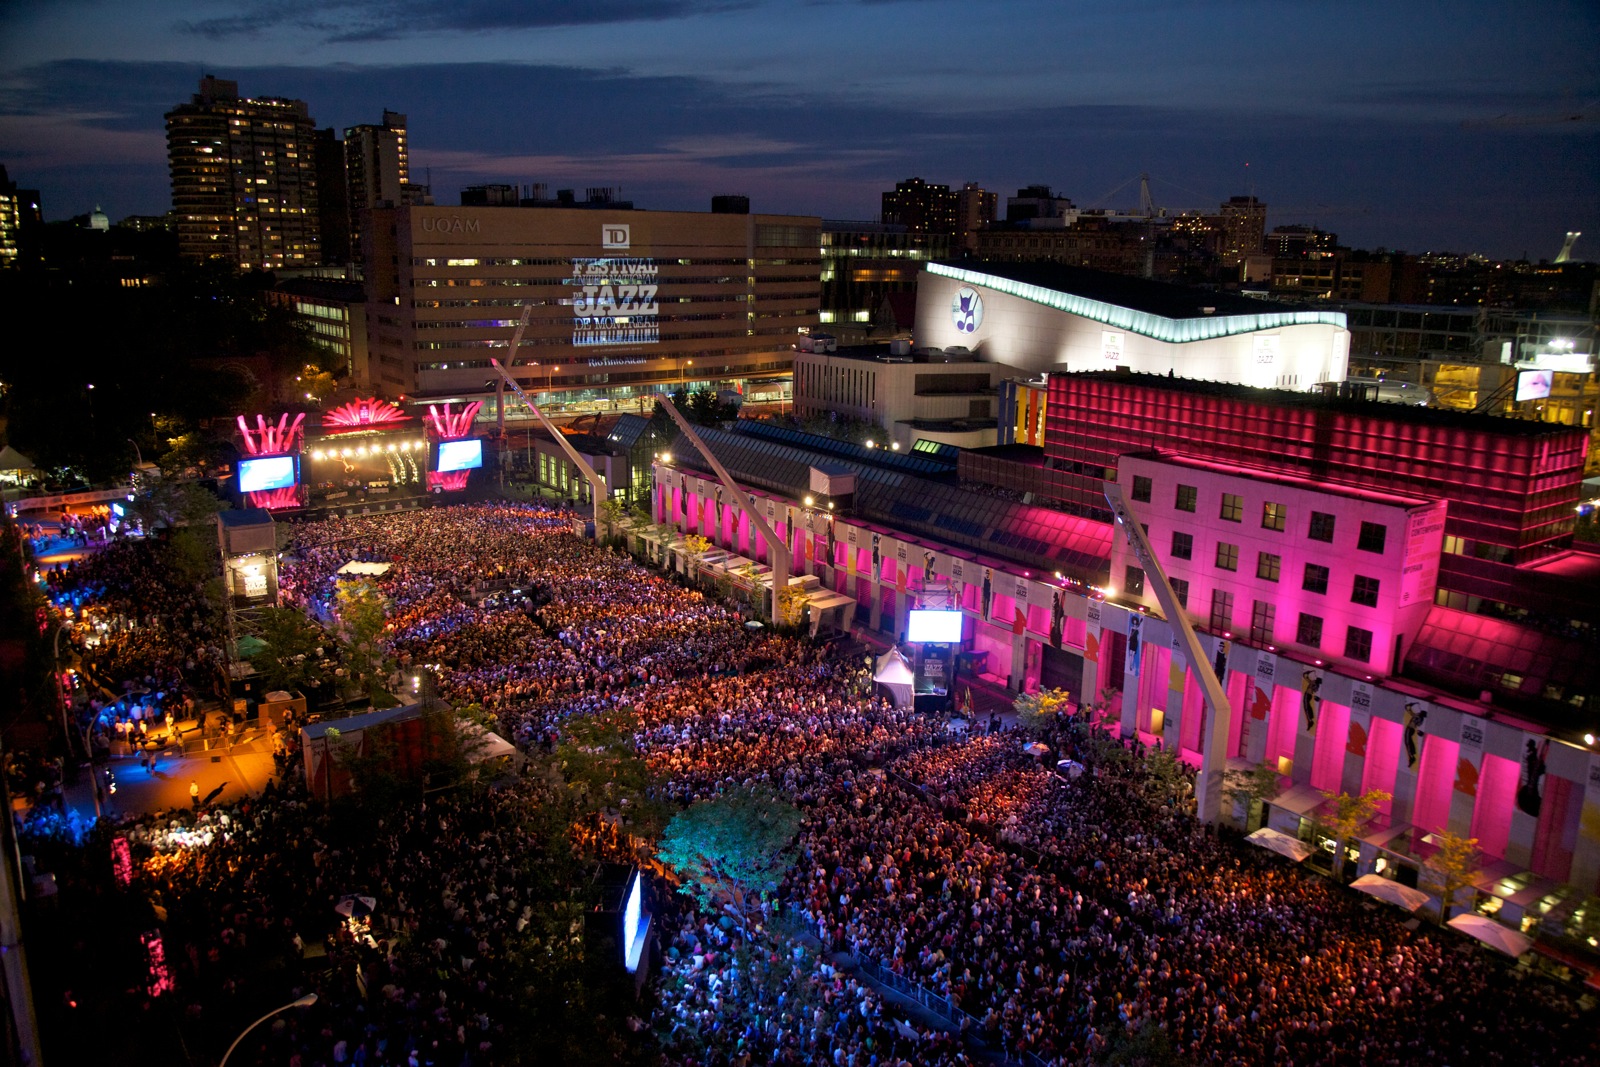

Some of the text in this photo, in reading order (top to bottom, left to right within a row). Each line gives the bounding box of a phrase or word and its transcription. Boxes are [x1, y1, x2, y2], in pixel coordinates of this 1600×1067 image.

[605, 229, 627, 243] TD
[573, 258, 658, 274] FESTIVAL
[574, 285, 659, 316] JAZZ
[574, 318, 592, 331] DE
